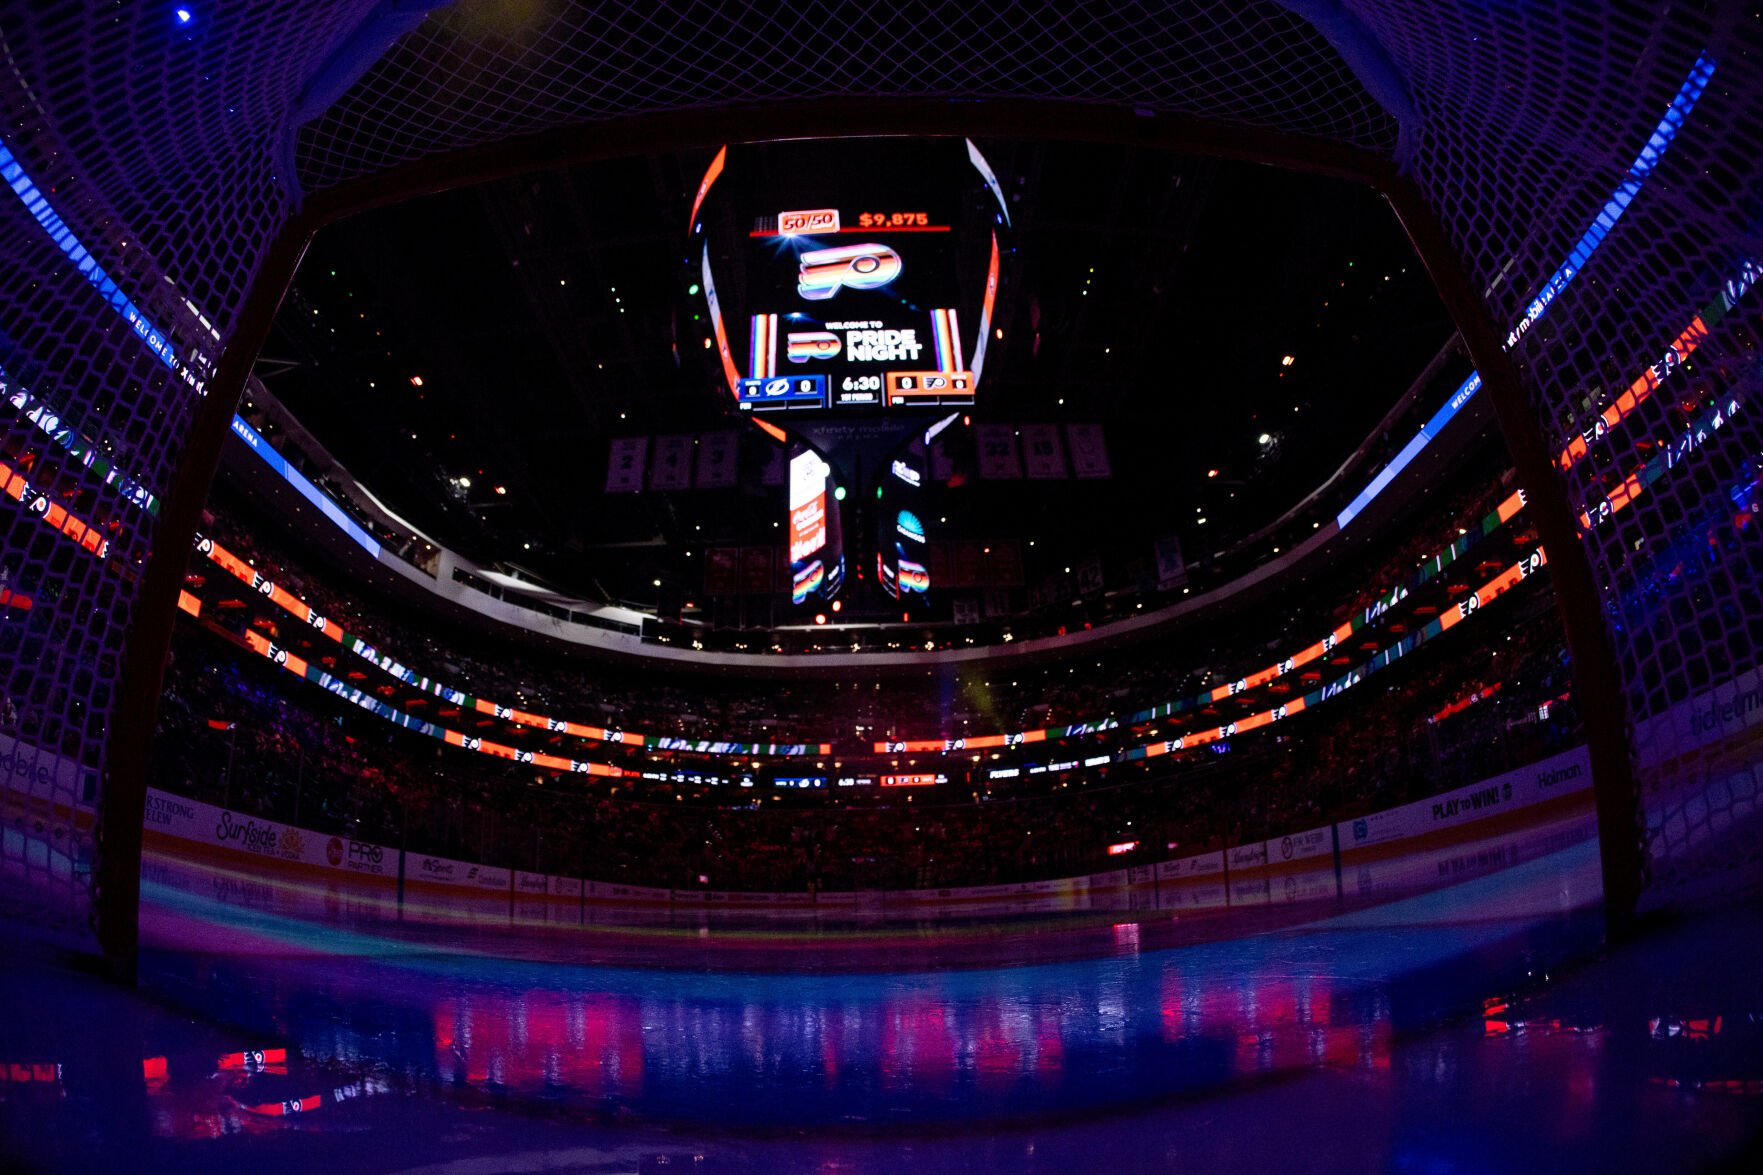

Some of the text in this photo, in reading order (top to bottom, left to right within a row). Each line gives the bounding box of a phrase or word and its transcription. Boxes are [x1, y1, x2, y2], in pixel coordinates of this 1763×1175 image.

[783, 211, 929, 231] 50/50 $9,875
[825, 320, 883, 330] WELCOME TO
[846, 329, 917, 346] PRIDE
[847, 344, 923, 361] NIGHT
[800, 380, 811, 393] 0
[842, 376, 880, 391] 6:30
[902, 377, 912, 389] 0
[1537, 764, 1583, 789] Holman
[1432, 797, 1459, 821] PLAY
[1470, 786, 1499, 809] WIN!
[216, 812, 277, 848] Surfside
